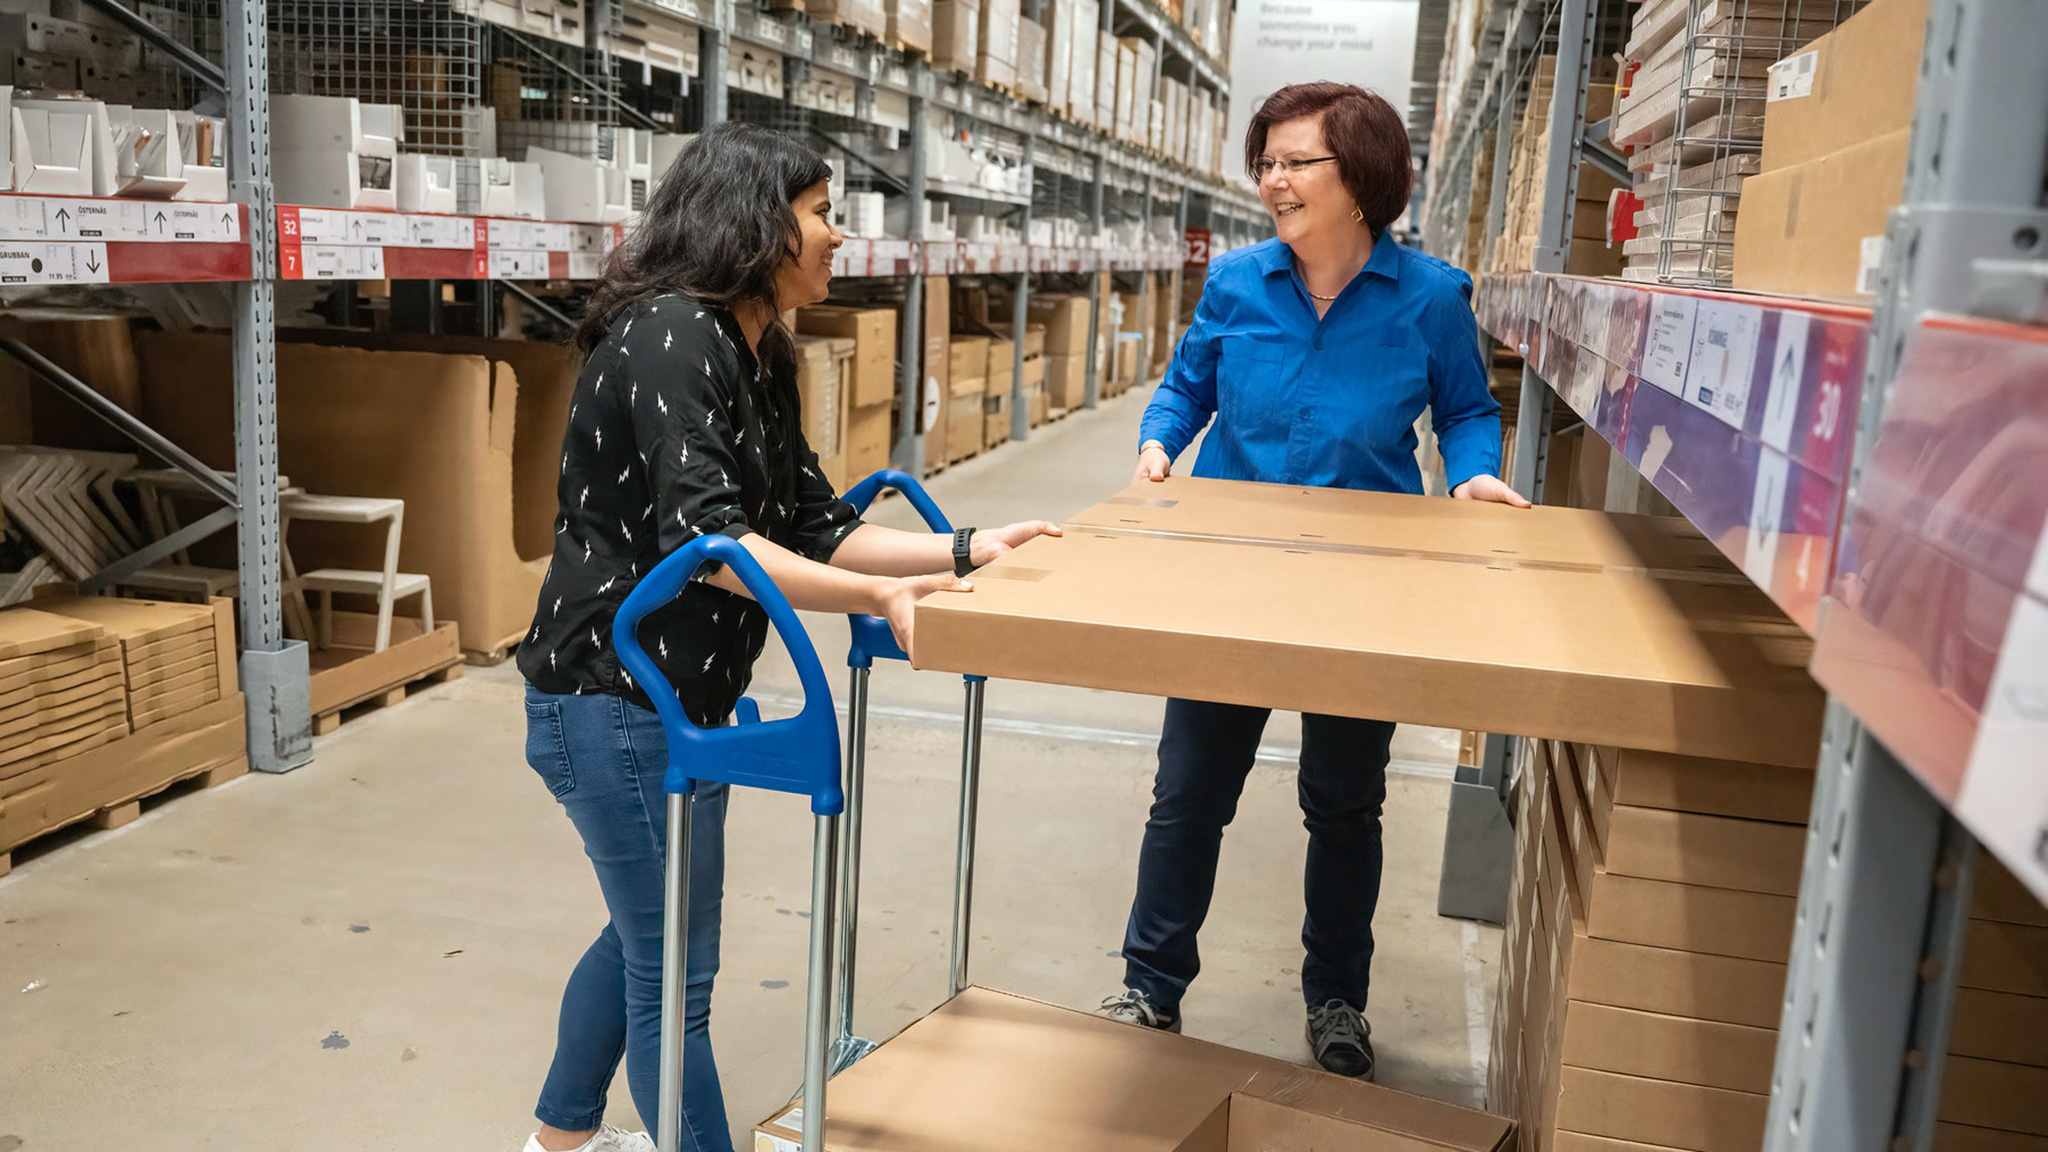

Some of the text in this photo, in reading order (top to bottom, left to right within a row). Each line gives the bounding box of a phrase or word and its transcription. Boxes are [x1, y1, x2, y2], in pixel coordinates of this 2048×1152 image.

[1259, 3, 1312, 14] Because
[1259, 21, 1357, 34] sometimes you
[1257, 37, 1373, 50] change your mind
[283, 220, 298, 235] 32
[288, 256, 296, 271] 7
[1813, 381, 1841, 441] 30
